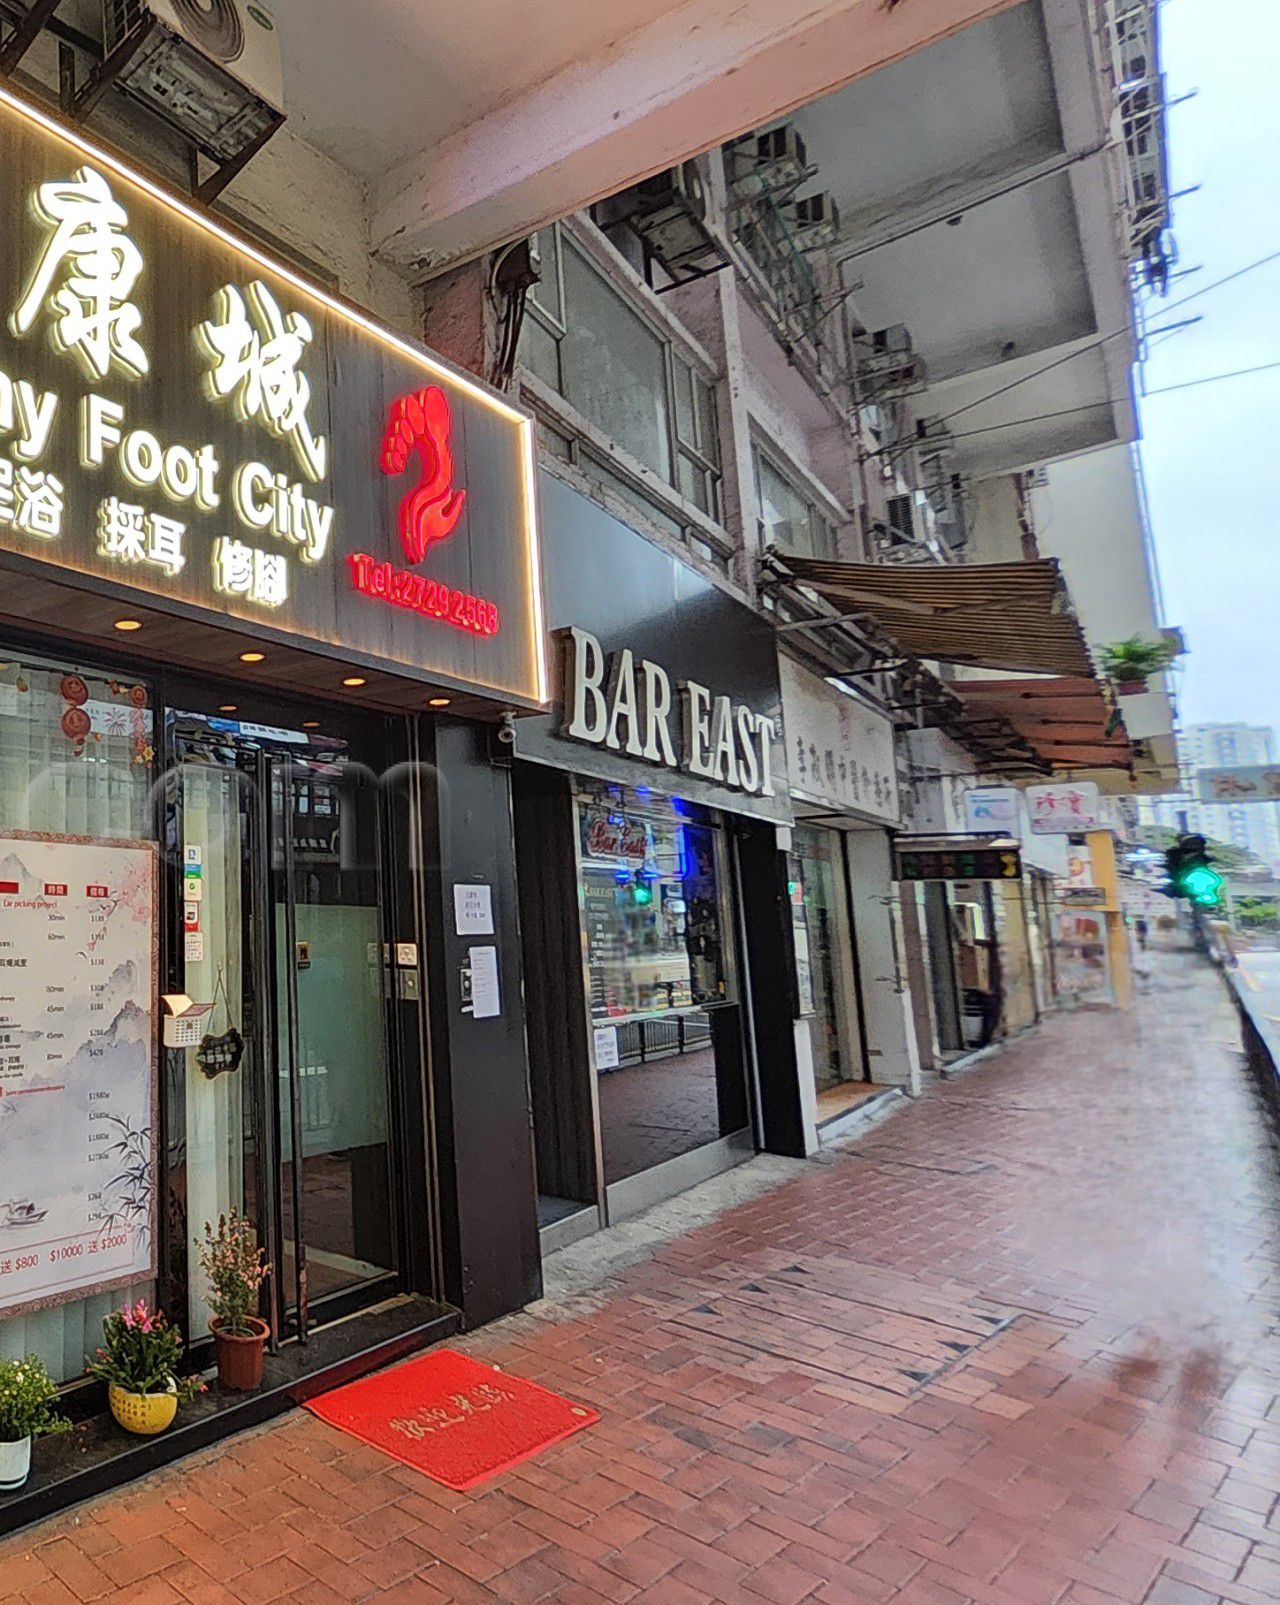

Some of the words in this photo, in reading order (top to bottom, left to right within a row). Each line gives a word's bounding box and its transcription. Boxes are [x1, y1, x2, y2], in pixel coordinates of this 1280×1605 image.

[81, 394, 220, 515] Foot
[234, 461, 335, 566] City
[100, 496, 186, 577] 採耳
[567, 626, 677, 767] BAR
[686, 681, 776, 797] EAST
[15, 1254, 39, 1271] $800
[101, 1234, 127, 1250] $2000
